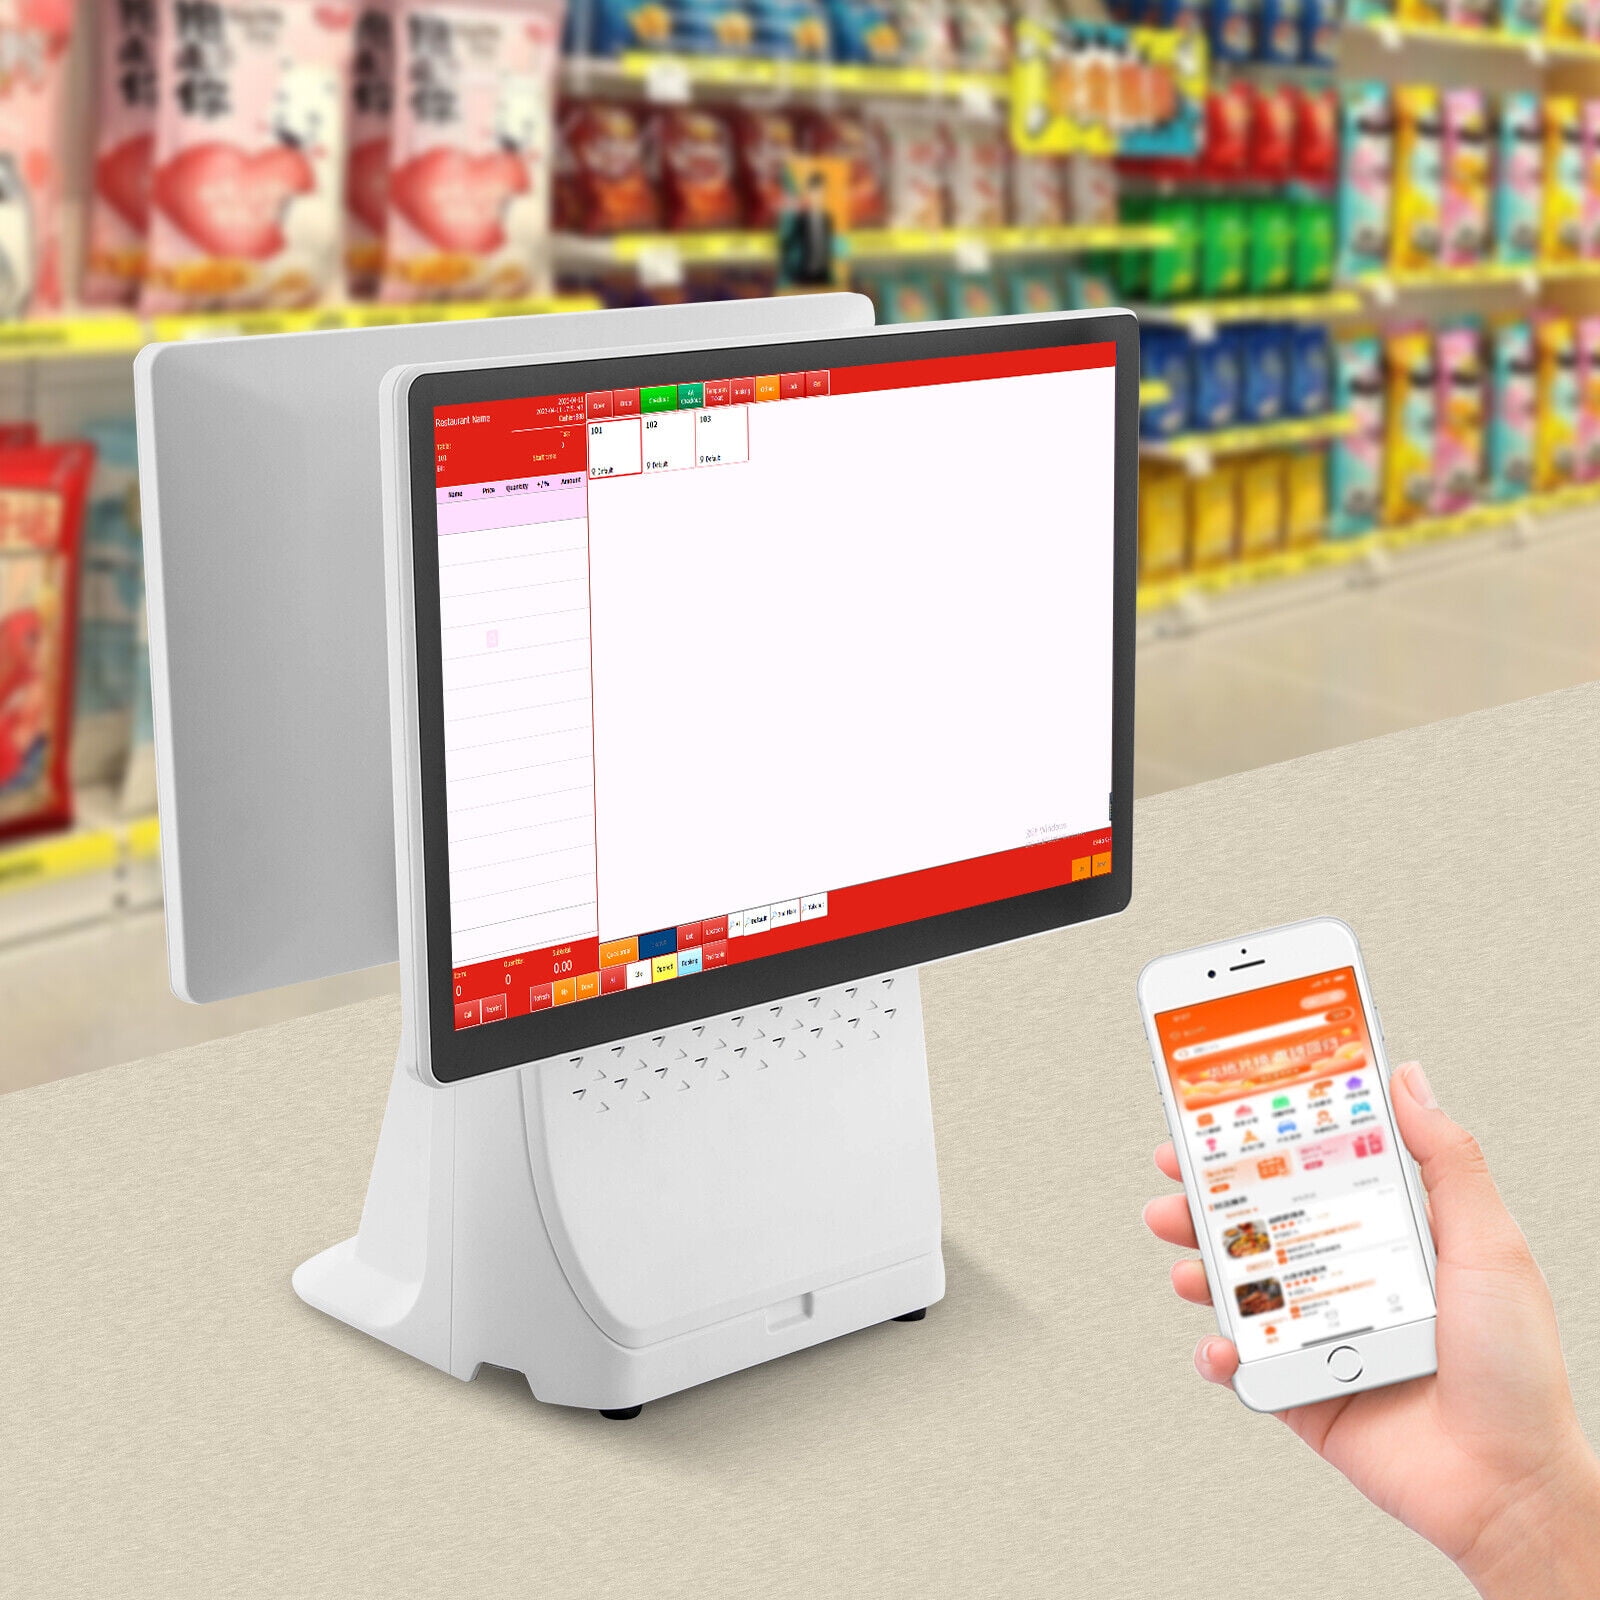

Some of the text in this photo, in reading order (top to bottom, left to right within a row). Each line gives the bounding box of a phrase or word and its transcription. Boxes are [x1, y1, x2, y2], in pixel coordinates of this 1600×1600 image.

[435, 414, 491, 427] Restaurant Name
[646, 420, 658, 429] 102
[699, 415, 712, 424] 103
[591, 426, 603, 435] 101
[553, 960, 573, 974] 0.00
[505, 974, 512, 985] 0
[455, 985, 462, 997] 0
